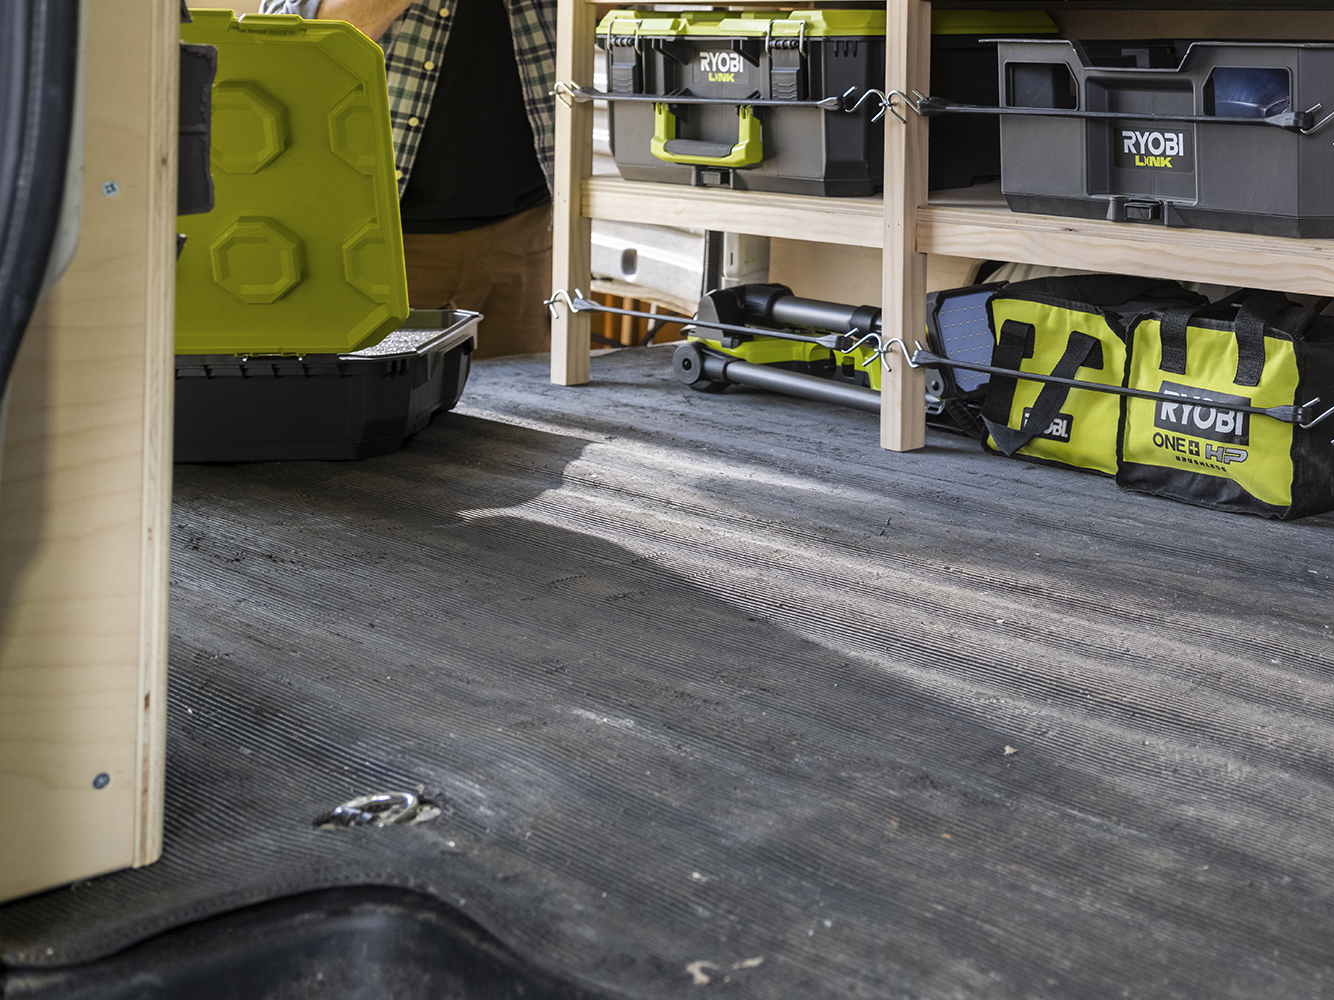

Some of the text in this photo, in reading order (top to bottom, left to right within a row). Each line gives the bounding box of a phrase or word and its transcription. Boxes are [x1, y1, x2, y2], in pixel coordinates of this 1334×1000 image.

[699, 51, 744, 73] RYOBI
[1122, 130, 1184, 157] RYOBI
[1160, 389, 1244, 436] RYOBI
[1175, 455, 1227, 472] BRUSHLESS
[1204, 443, 1249, 465] HP
